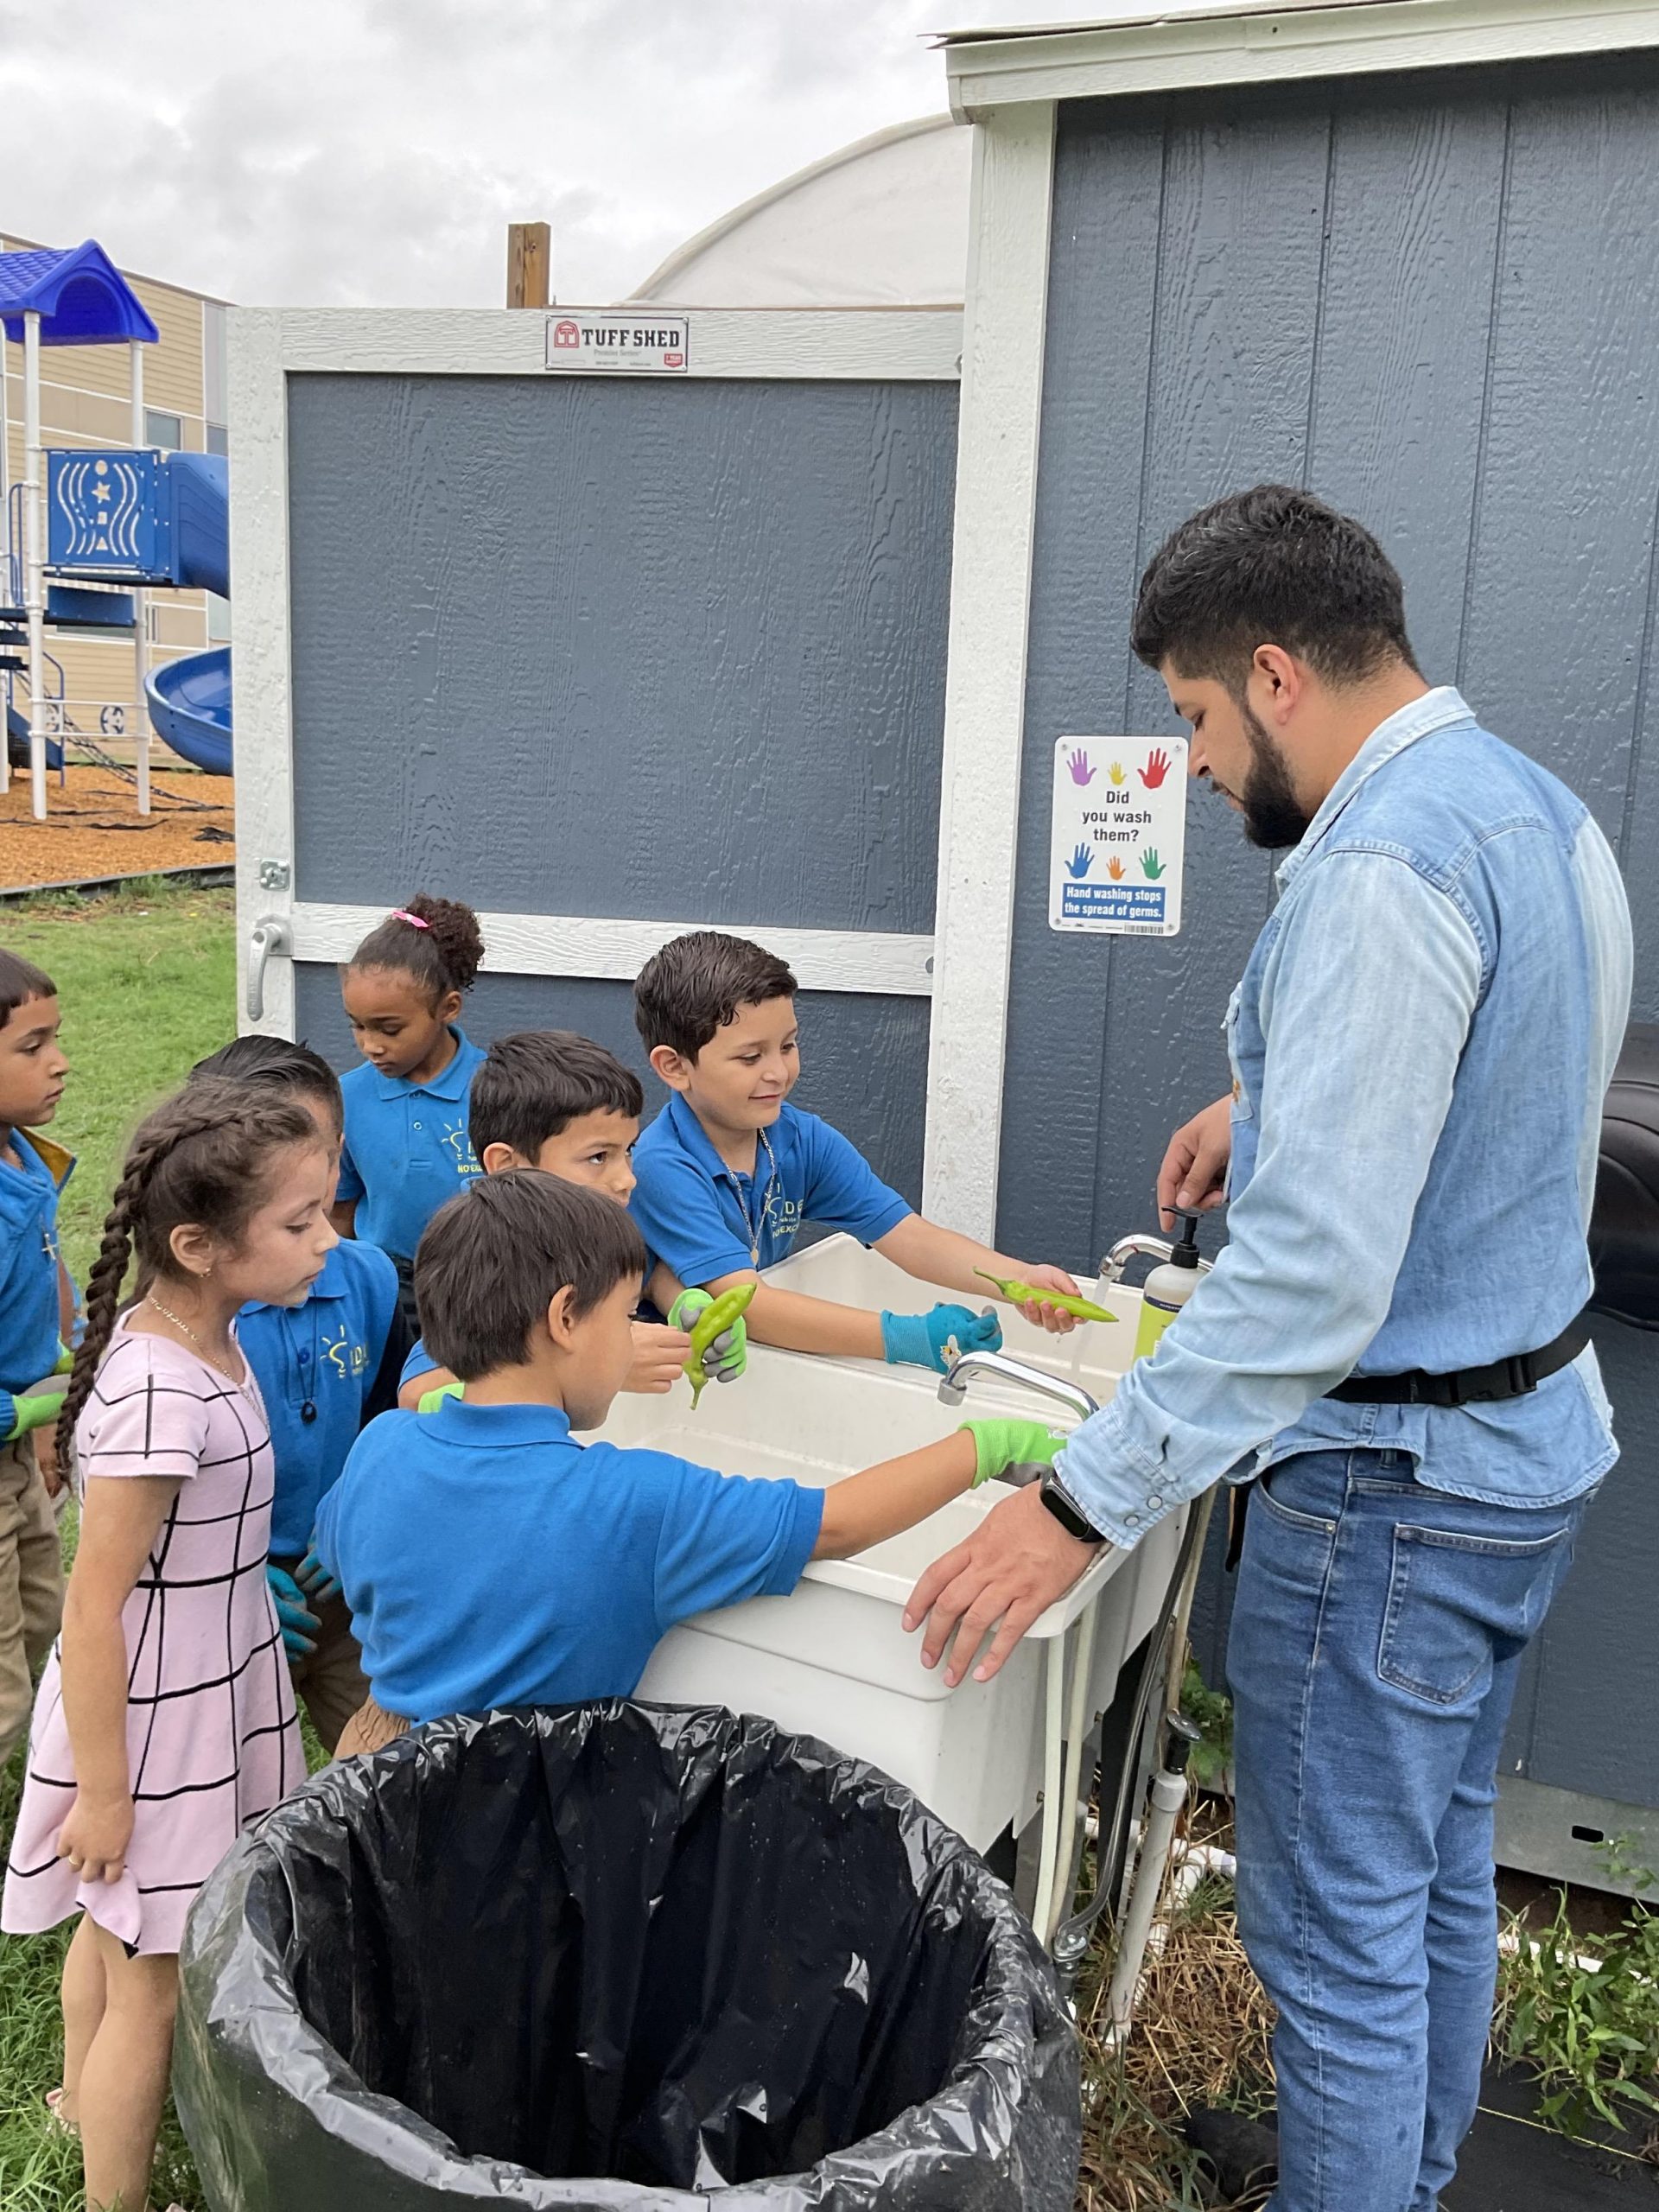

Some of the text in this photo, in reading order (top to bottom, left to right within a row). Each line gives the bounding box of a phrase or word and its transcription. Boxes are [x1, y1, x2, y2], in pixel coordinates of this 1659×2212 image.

[582, 329, 680, 348] TUFF SHED
[1106, 791, 1129, 804] Did
[1083, 810, 1152, 824] you wash
[1093, 829, 1140, 842] them?
[1066, 887, 1162, 903] Hand washing stops
[1065, 902, 1162, 918] the spread of germs.
